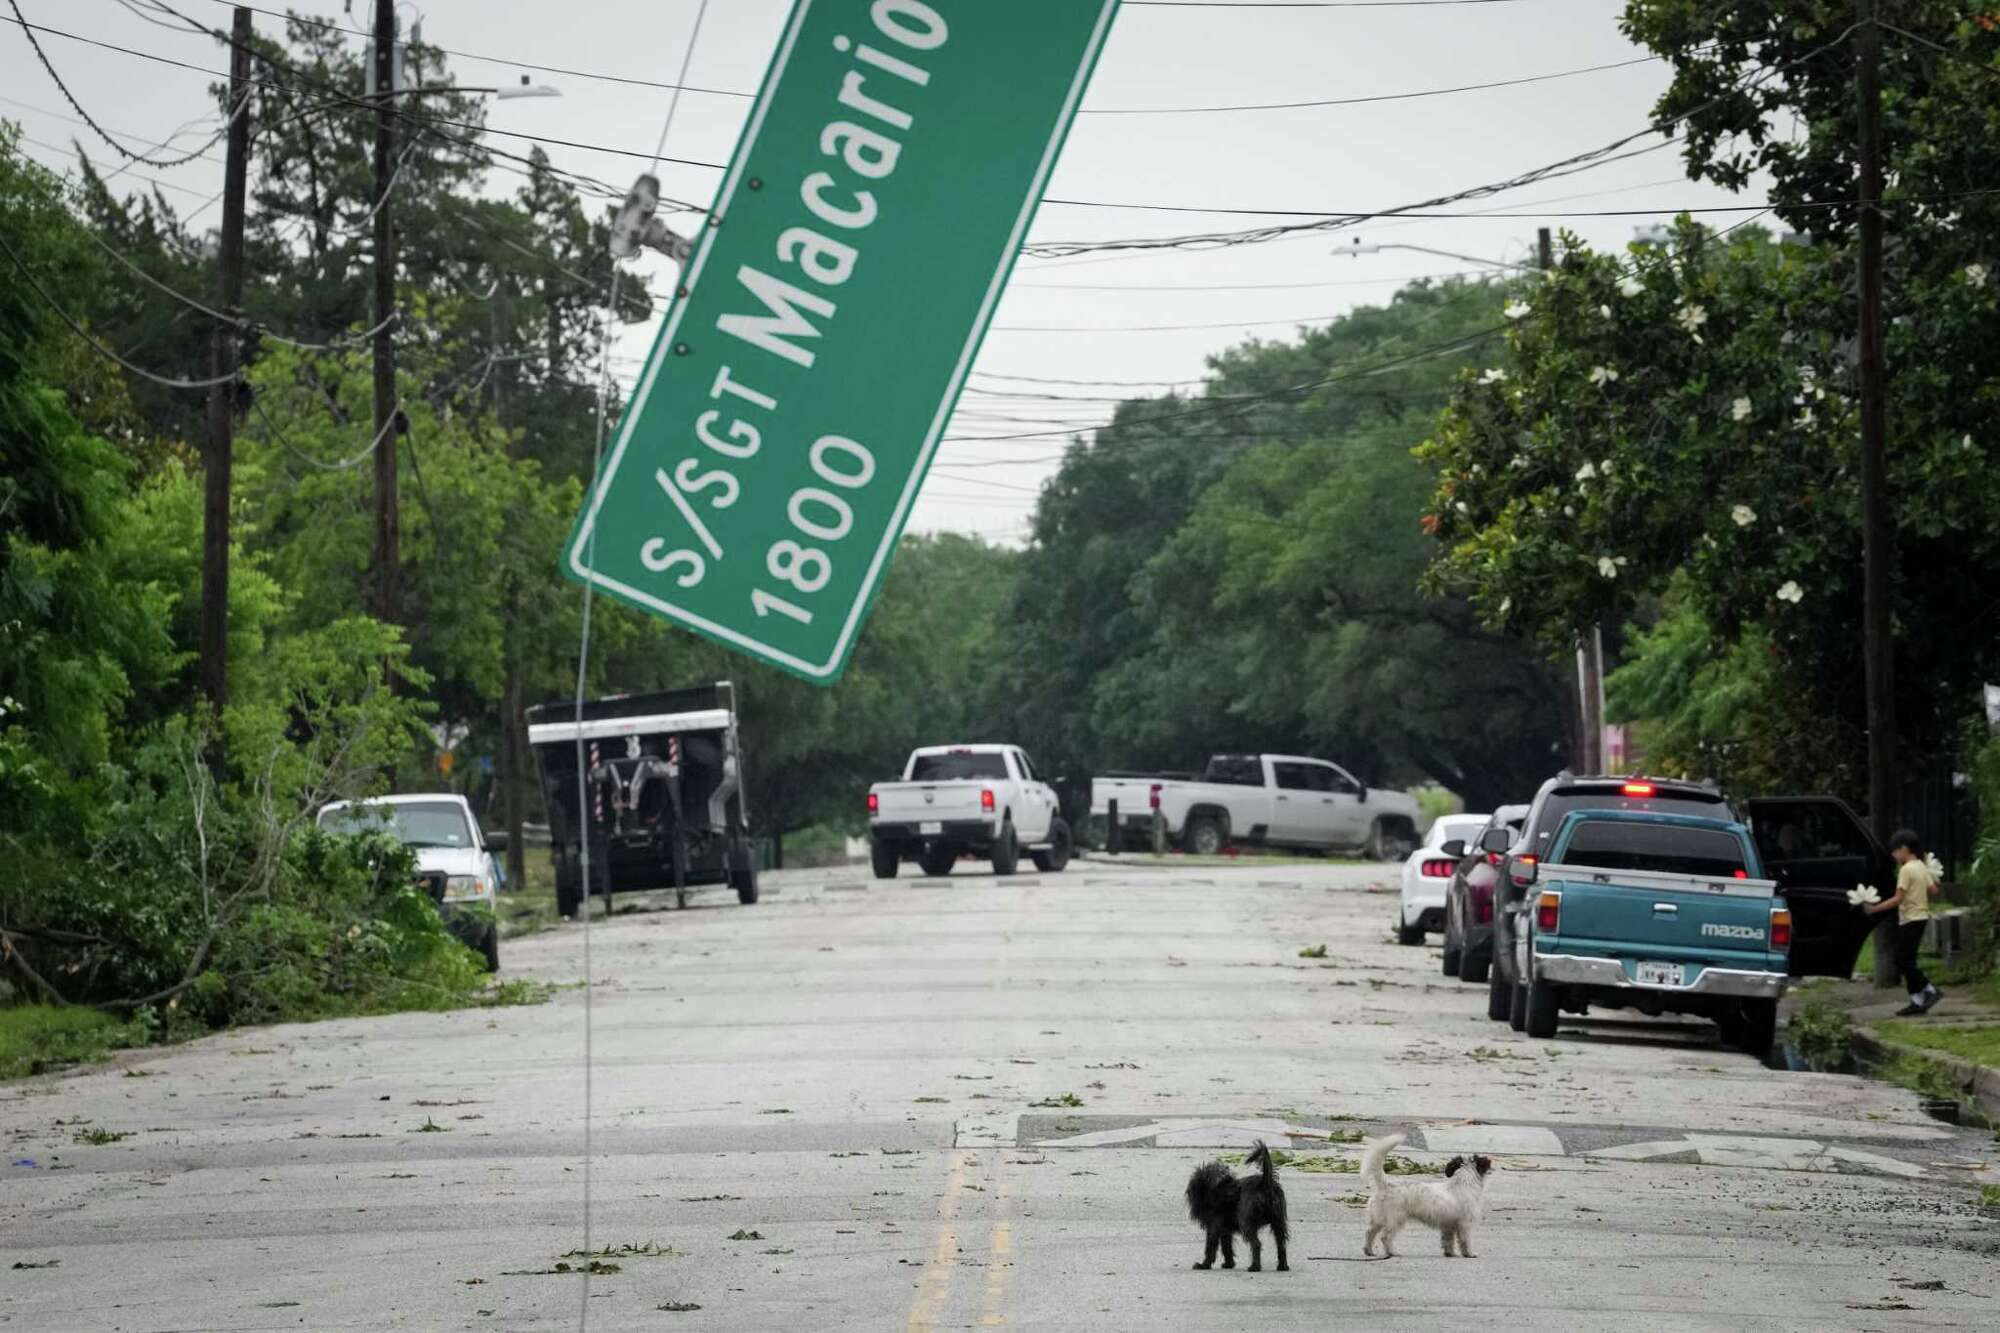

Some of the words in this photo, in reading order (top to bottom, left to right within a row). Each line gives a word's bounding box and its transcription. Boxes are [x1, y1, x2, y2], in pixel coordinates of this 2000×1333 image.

[641, 366, 777, 588] S/SGT
[716, 0, 947, 368] Macario
[751, 435, 875, 624] 1800
